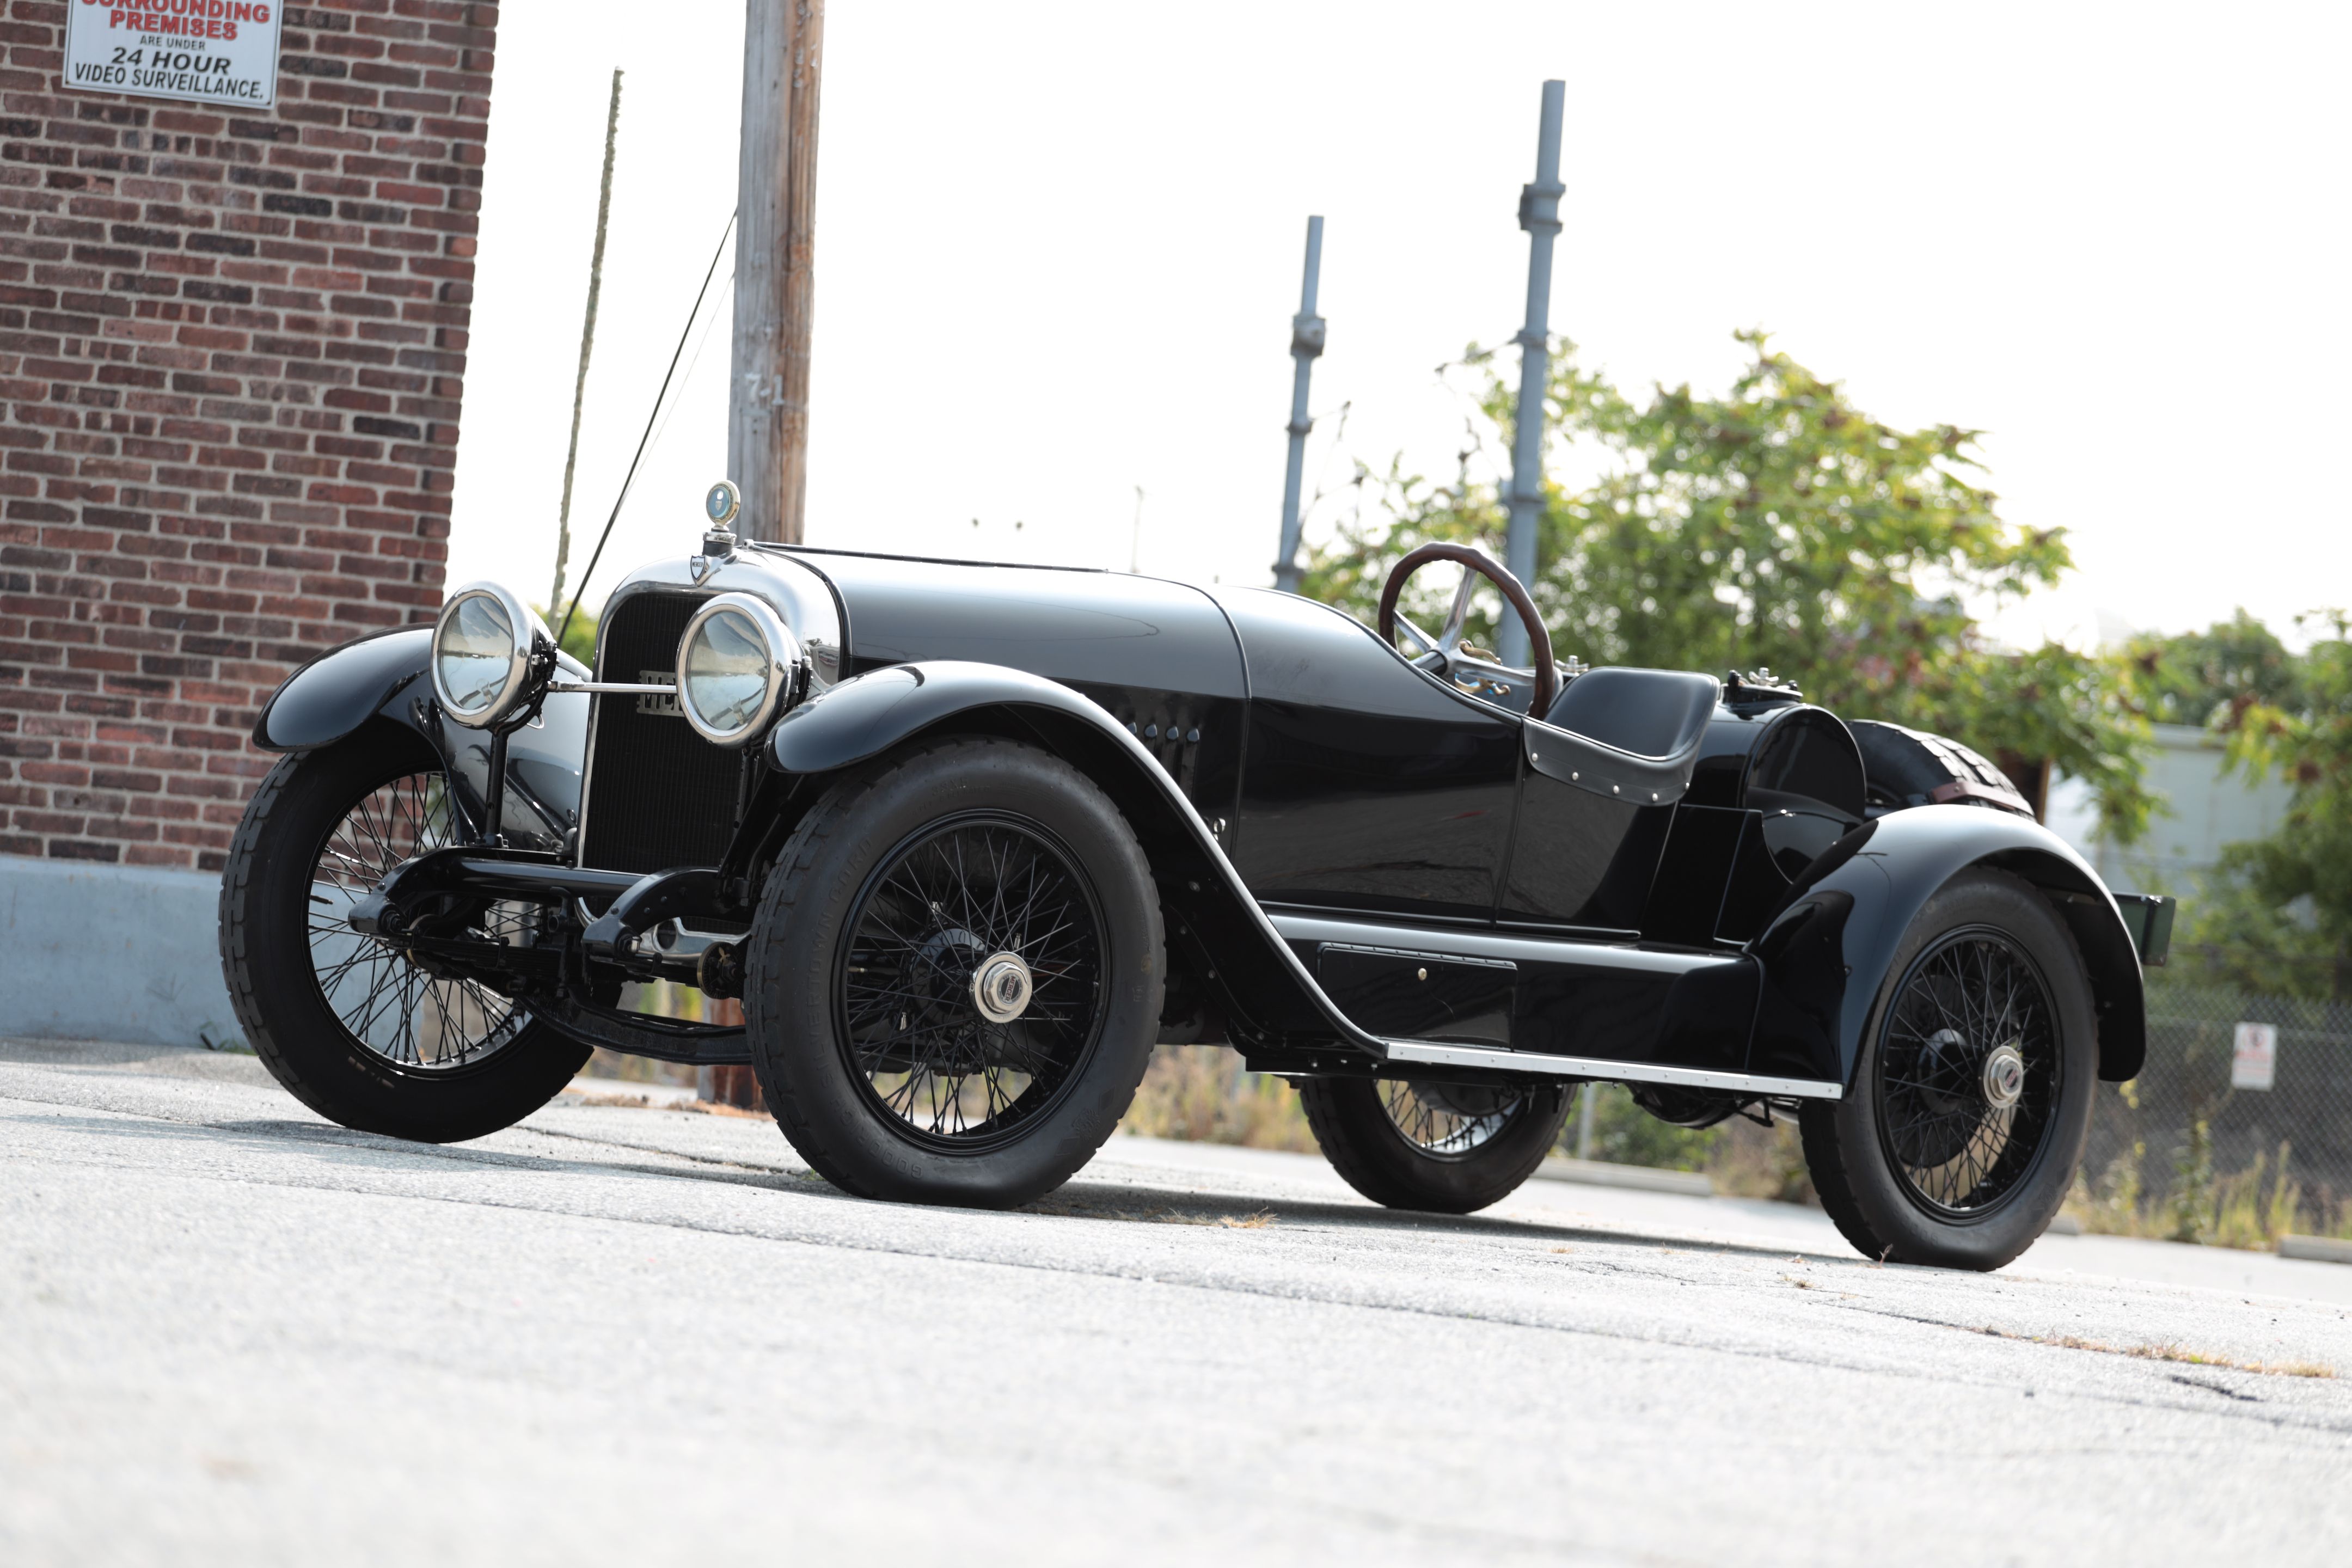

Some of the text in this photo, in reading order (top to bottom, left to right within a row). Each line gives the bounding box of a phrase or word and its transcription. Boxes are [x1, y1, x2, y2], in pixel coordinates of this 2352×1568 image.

[82, 0, 270, 23] ROUNDING
[110, 9, 237, 41] PREMISES
[140, 35, 205, 51] ARE UNDER
[112, 47, 231, 75] 24 HOUR
[76, 63, 263, 99] VIDEO SURVEILLANCE.
[806, 911, 834, 1088] SILVERTOWN
[828, 837, 872, 903] CORD
[1004, 976, 1016, 1001] MERCER
